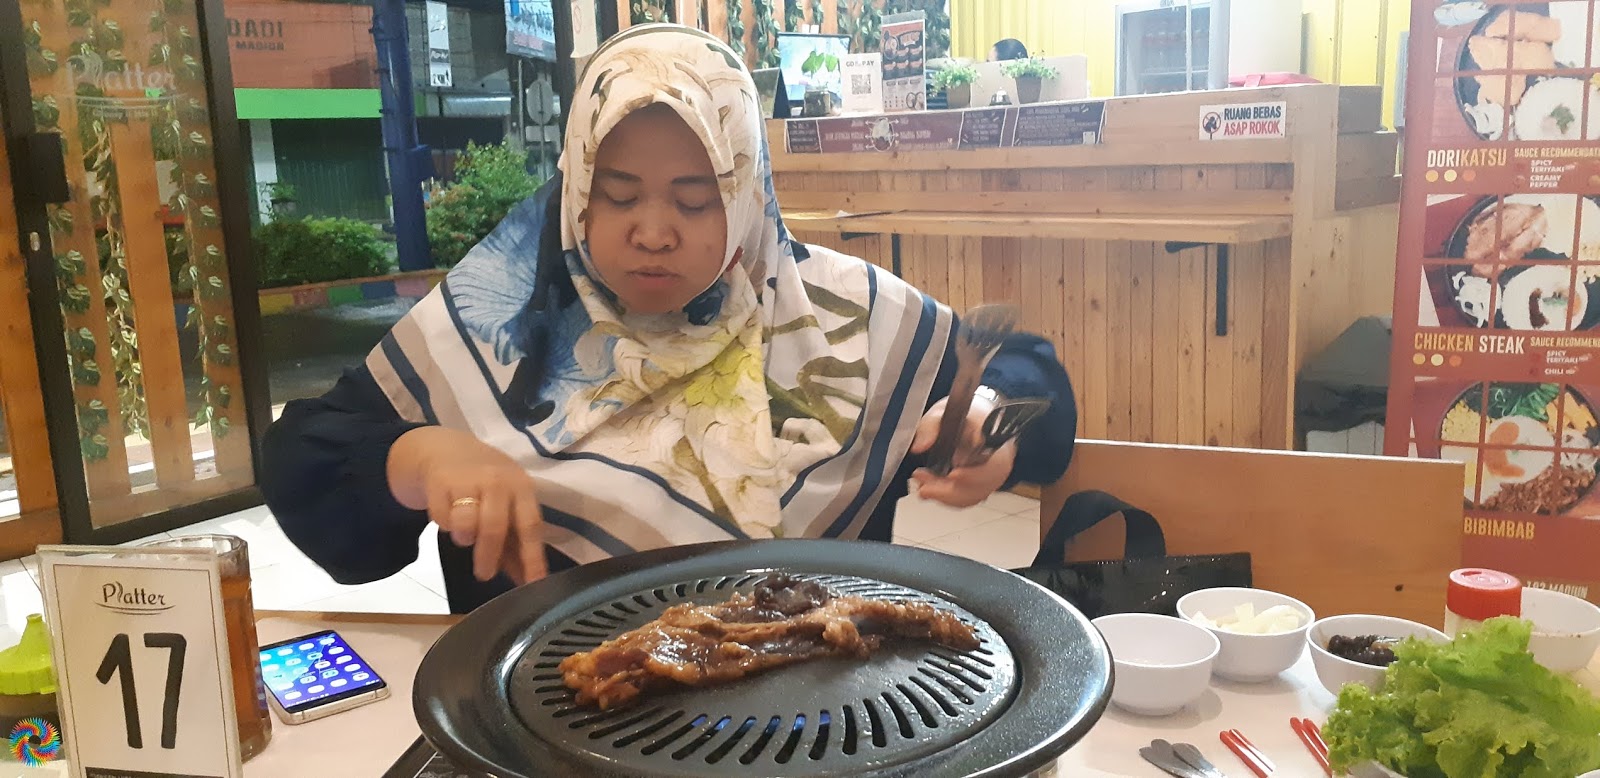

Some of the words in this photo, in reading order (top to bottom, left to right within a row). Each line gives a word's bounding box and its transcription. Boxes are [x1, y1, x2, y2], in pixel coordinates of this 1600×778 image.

[1223, 107, 1252, 121] RUANG
[1253, 105, 1282, 119] BEBAS
[1223, 121, 1248, 136] ASAP
[1249, 120, 1281, 135] ROKOK
[1514, 147, 1538, 158] SAUCE
[1530, 159, 1553, 167] SPICY
[1529, 174, 1561, 182] CREAMY
[1414, 332, 1474, 352] CHICKEN
[1479, 335, 1525, 354] STEAK
[1530, 336, 1555, 347] SAUCE
[1546, 350, 1567, 358] SPICY
[1546, 356, 1579, 365] TERIYAKI
[1544, 367, 1564, 375] CHILI
[1463, 517, 1535, 540] BIBIMBAB
[102, 580, 166, 606] Platter
[95, 632, 187, 750] 17
